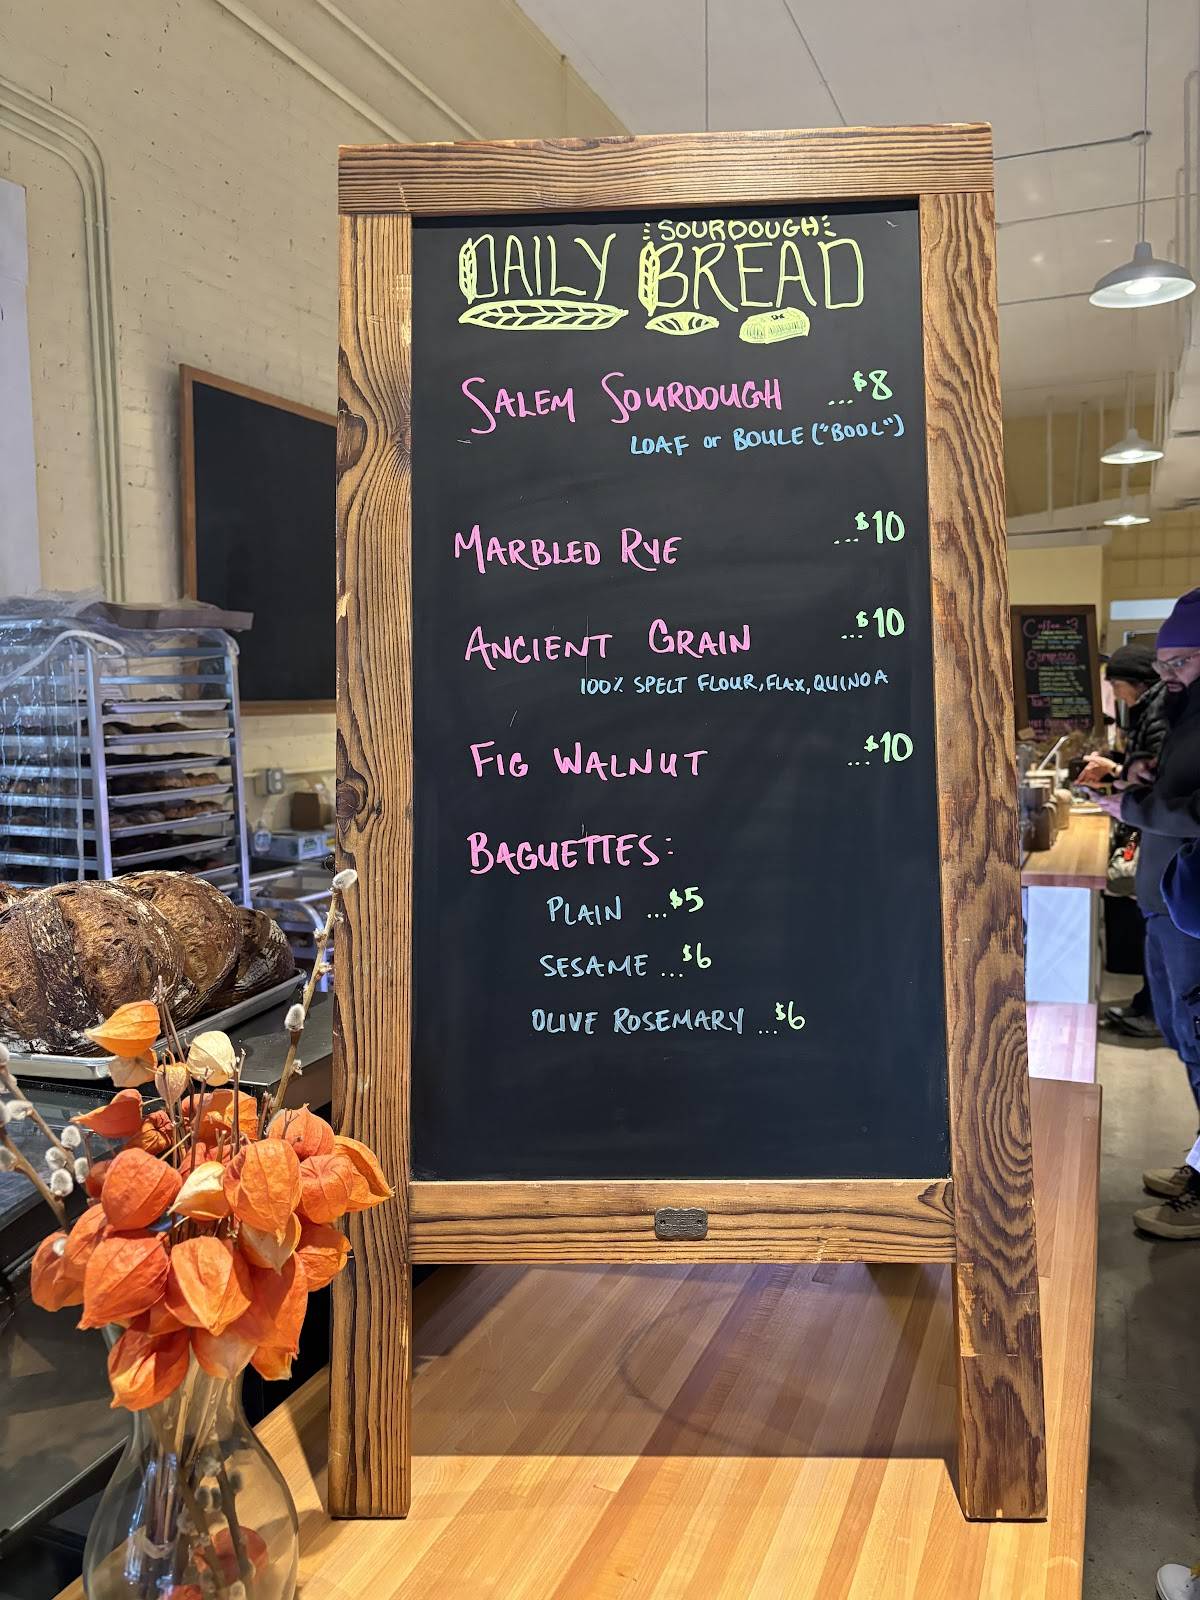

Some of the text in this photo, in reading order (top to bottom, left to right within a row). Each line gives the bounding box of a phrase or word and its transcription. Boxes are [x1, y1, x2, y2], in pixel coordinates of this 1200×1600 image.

[657, 216, 819, 241] SOURDOUGH
[458, 233, 864, 317] DAILY BREAD
[462, 376, 576, 435] SALEM
[601, 372, 783, 424] SOURDOUGH
[630, 413, 905, 456] LOAF or BOULE ("BOOL")
[454, 525, 601, 574] MARBLED
[621, 528, 683, 571] RYE
[465, 626, 613, 670] ANCIENT
[648, 619, 751, 658] GRAIN
[580, 676, 624, 695] 100%
[633, 676, 688, 694] SPELT
[470, 741, 529, 778] FIG
[553, 742, 709, 780] WALNUT
[466, 831, 674, 875] BAGUETTES:
[547, 895, 623, 926] PLAIN
[539, 954, 649, 978] SESAME
[531, 1008, 599, 1034] OLIVE
[613, 1007, 745, 1035] ROSEMARY
